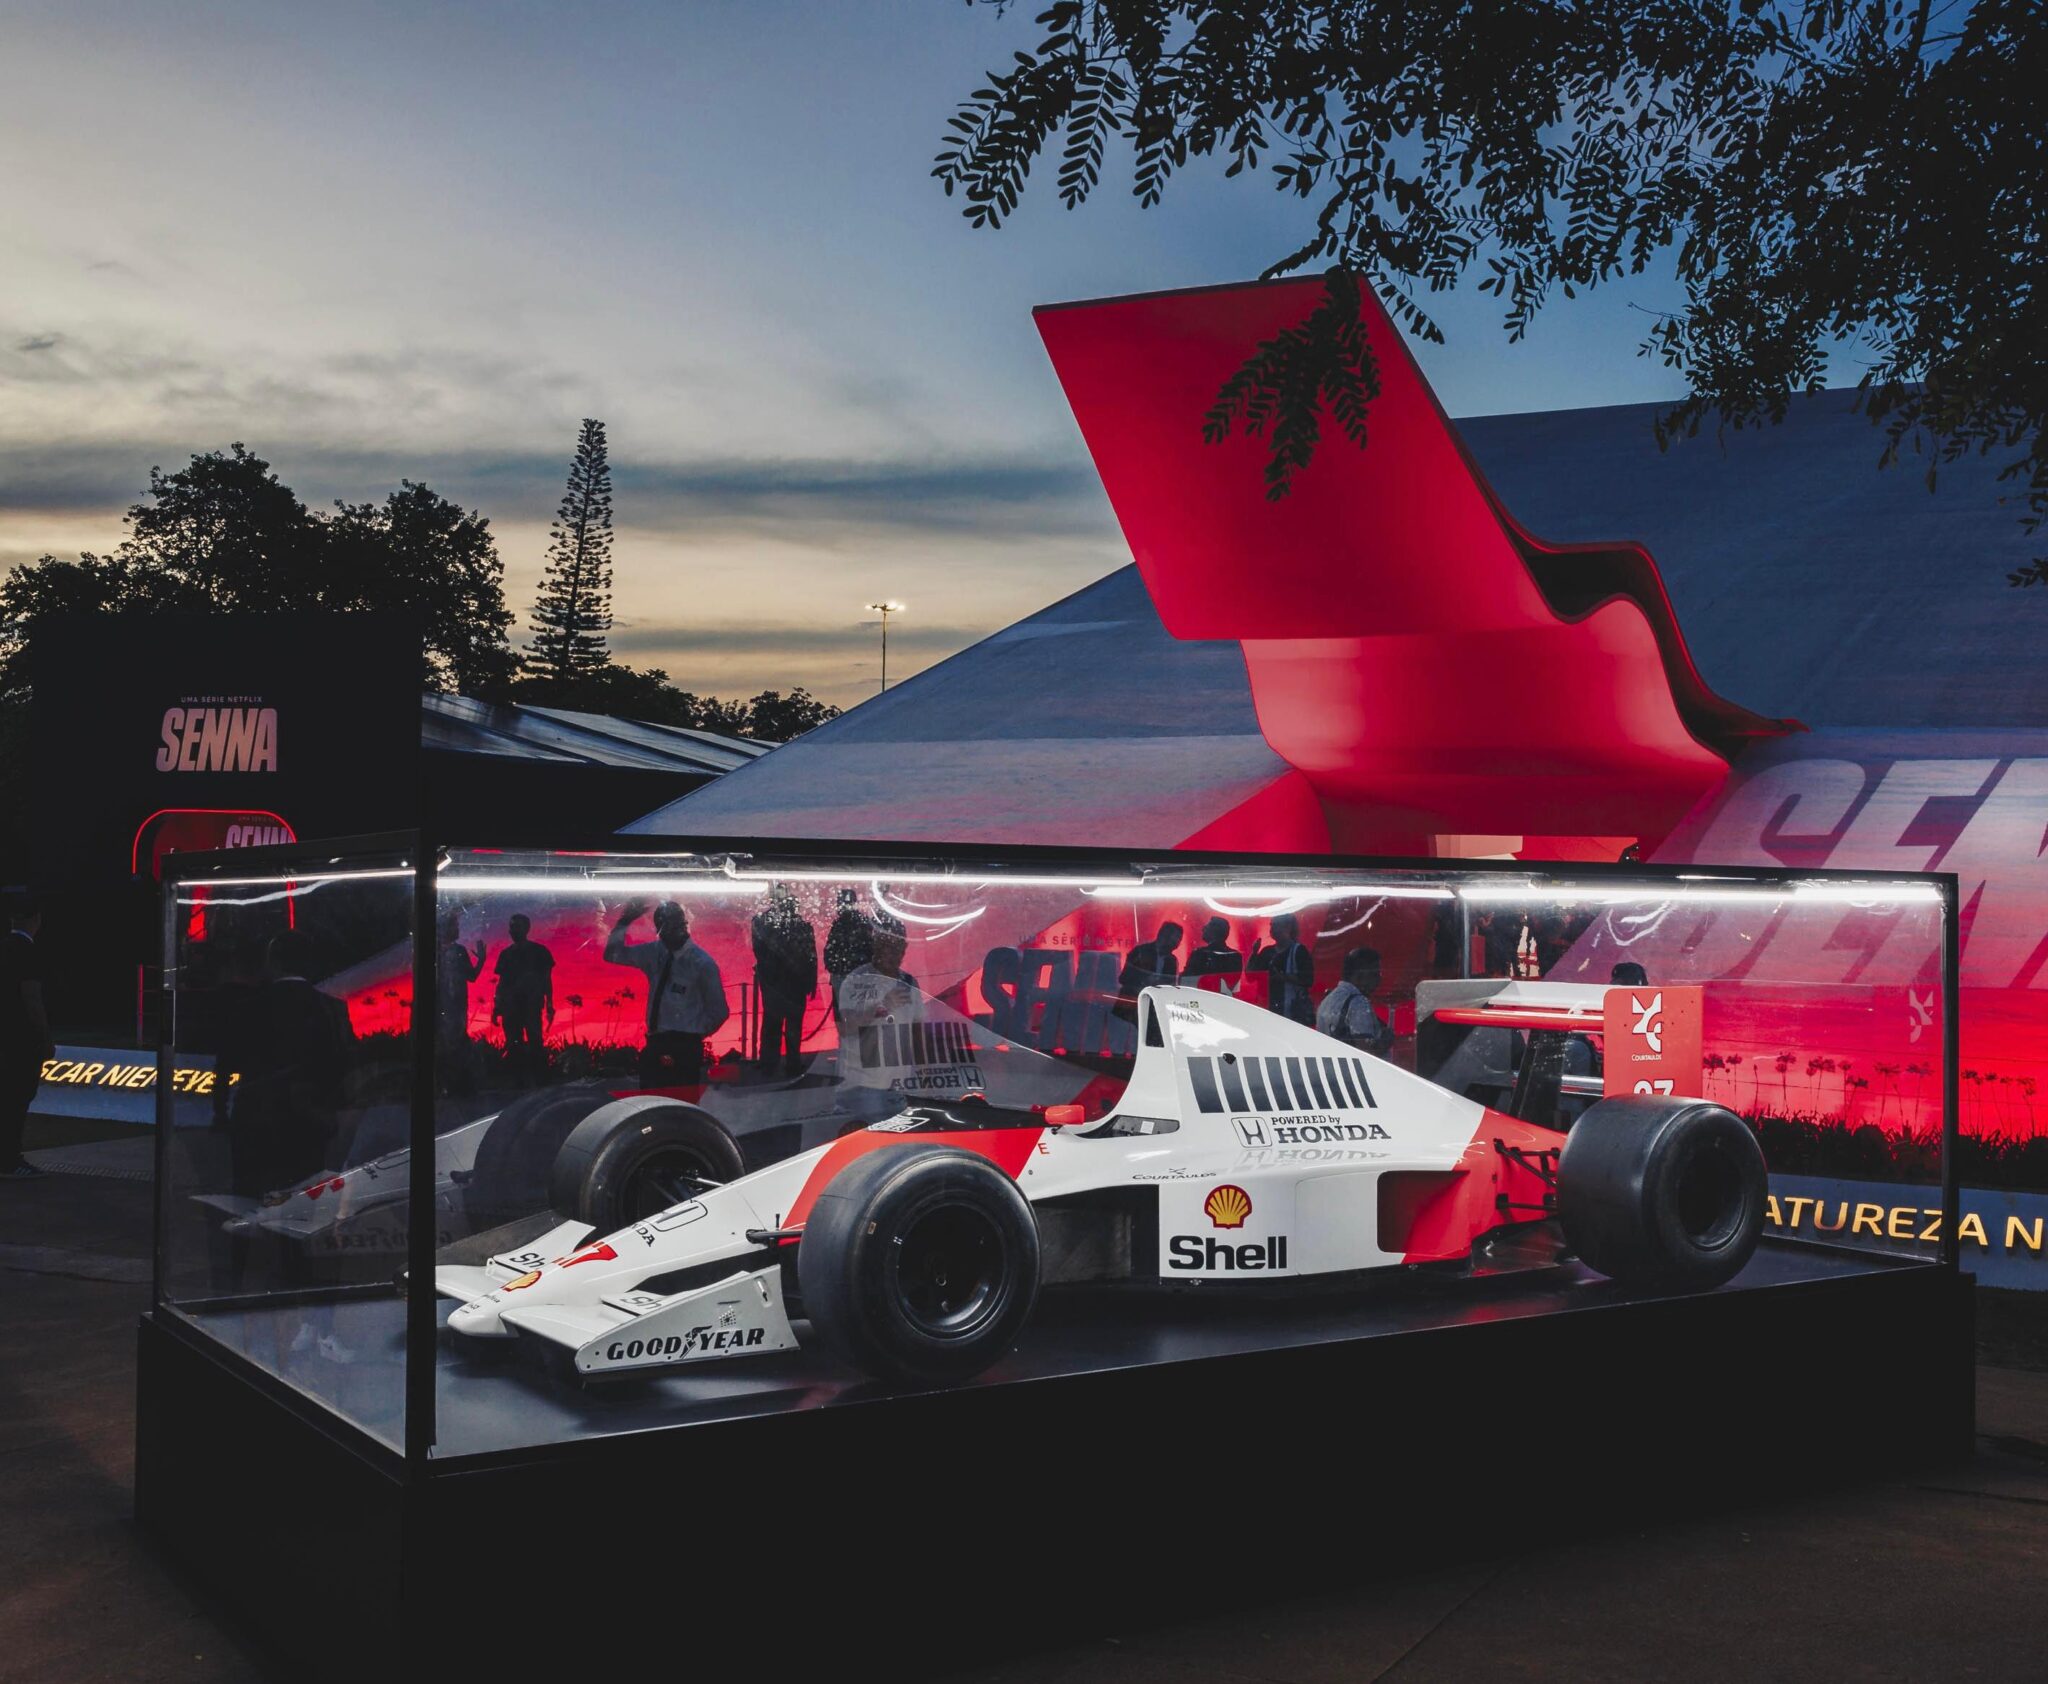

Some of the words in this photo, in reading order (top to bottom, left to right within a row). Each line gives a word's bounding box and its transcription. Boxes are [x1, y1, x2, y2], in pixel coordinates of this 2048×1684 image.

[155, 707, 278, 772] SENNA
[1618, 758, 2048, 988] SEN
[972, 946, 1138, 1058] SENN
[40, 1060, 104, 1084] SCAR
[98, 1064, 241, 1094] NIEEYE
[1271, 1116, 1326, 1126] POWERED
[1328, 1115, 1341, 1126] by
[1273, 1123, 1392, 1144] HONDA
[1037, 1142, 1050, 1155] E
[1765, 1195, 1989, 1247] ATUREZA
[1168, 1235, 1288, 1271] Shell
